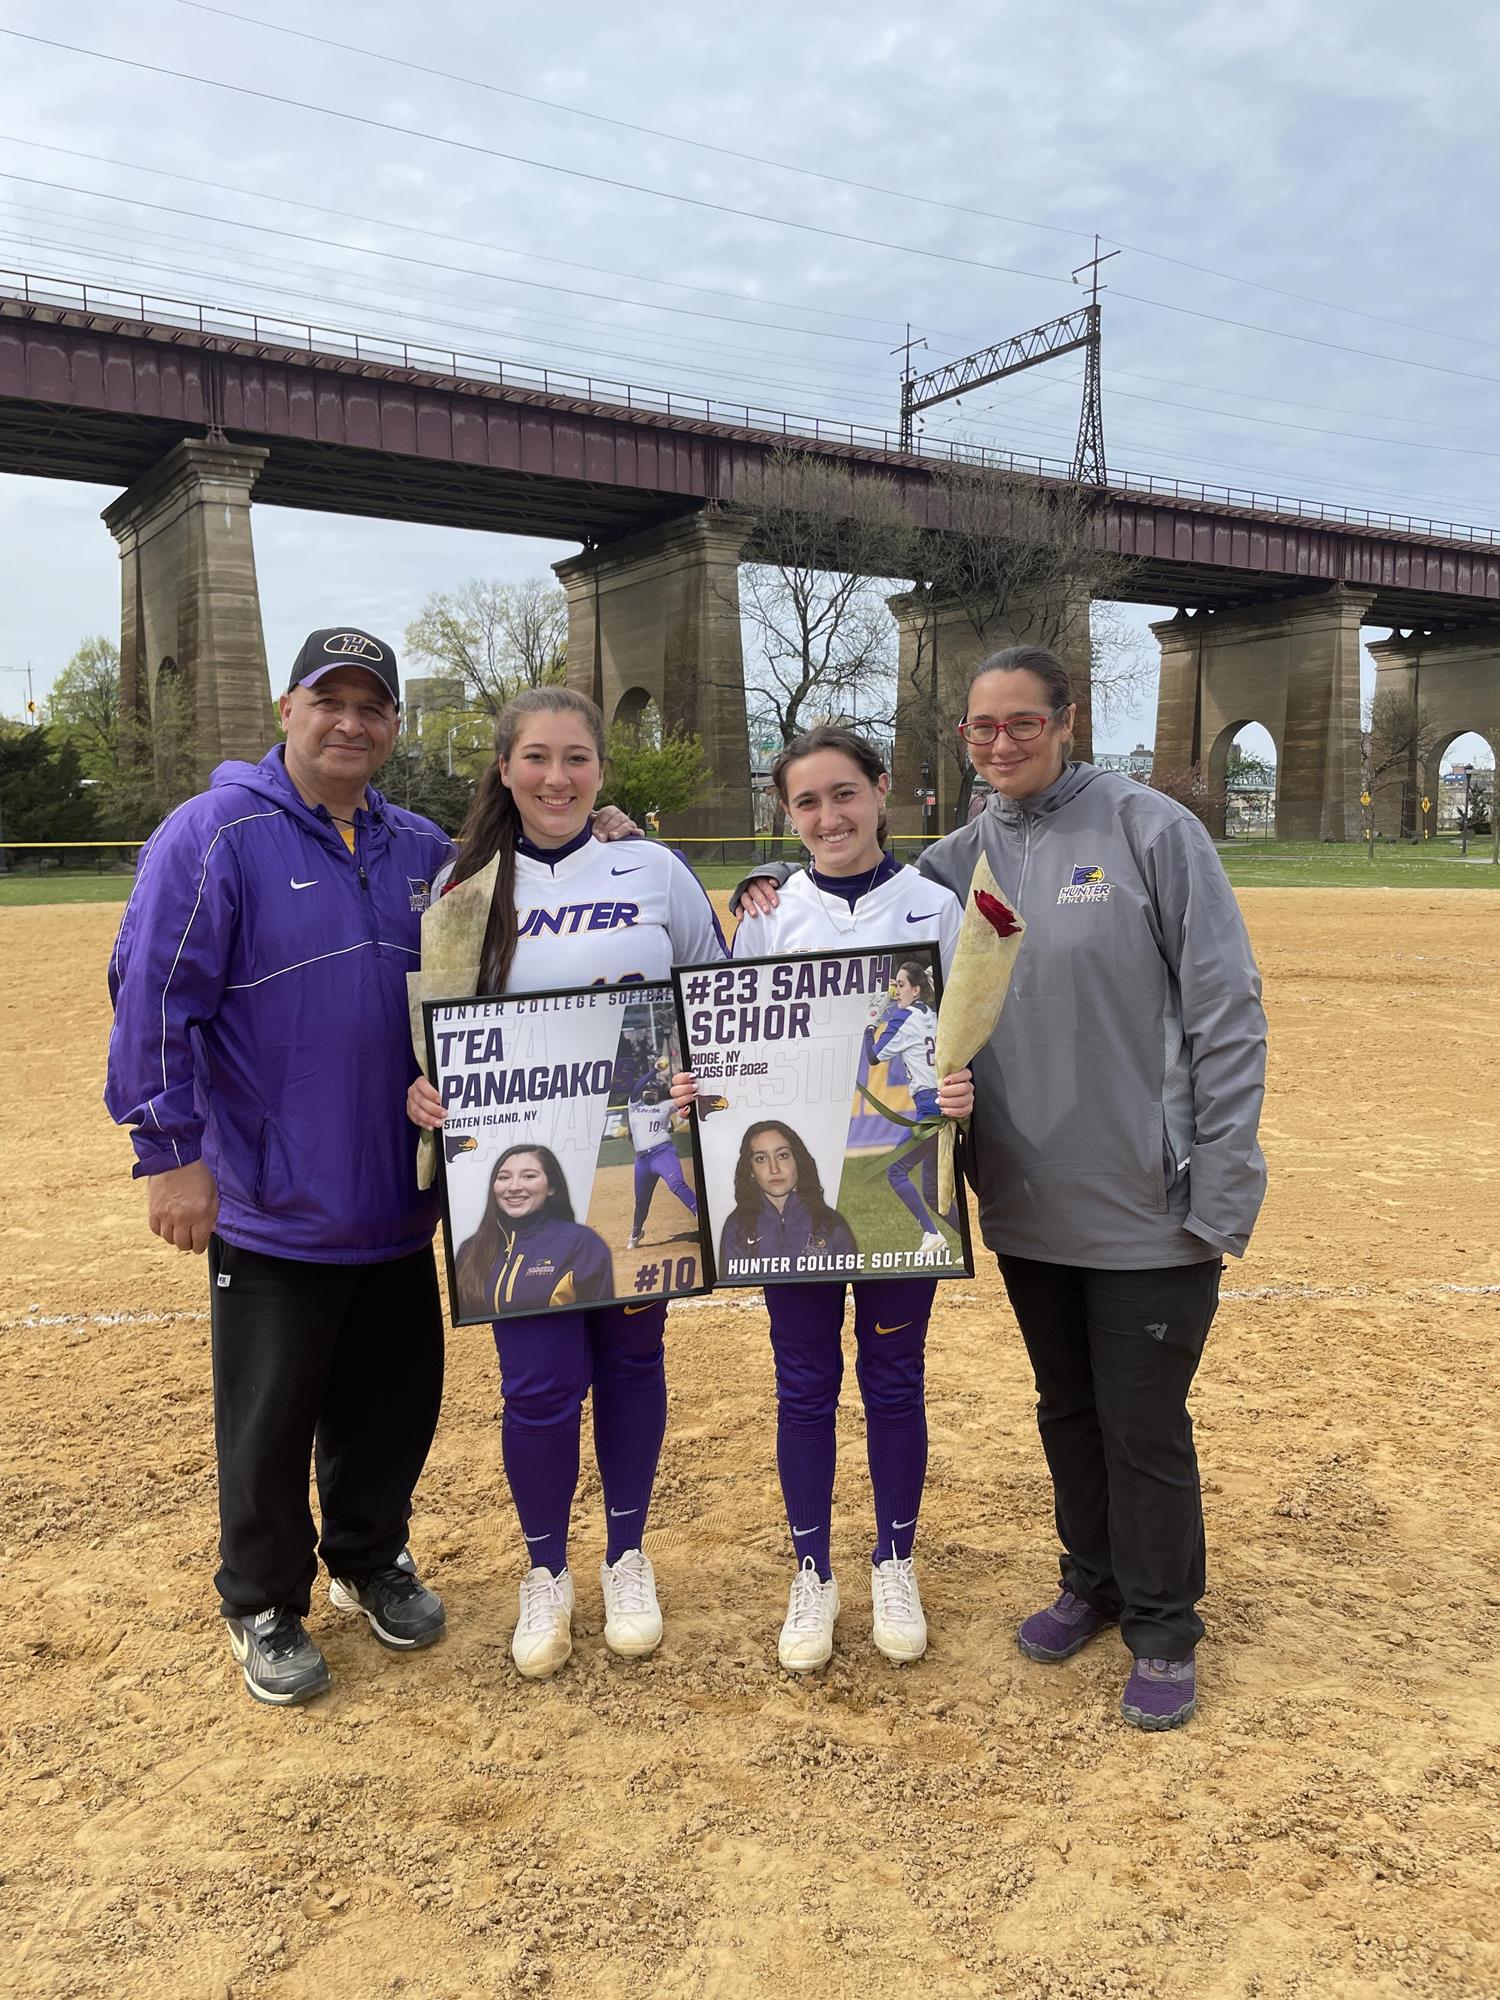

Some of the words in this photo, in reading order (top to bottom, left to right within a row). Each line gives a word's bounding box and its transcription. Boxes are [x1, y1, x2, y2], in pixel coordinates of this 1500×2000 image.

[1056, 896, 1108, 905] ATHLETICS
[1059, 884, 1111, 899] HUNTER
[516, 901, 641, 939] UNTER
[685, 968, 758, 1007] #23
[771, 955, 893, 1002] SARAH
[432, 1003, 504, 1022] HUNTER
[516, 994, 597, 1014] COLLEGE
[608, 986, 673, 1006] SOFTBAL
[691, 1002, 811, 1047] SCHOR
[437, 1027, 505, 1067] T'EA
[726, 1050, 741, 1063] NY
[692, 1065, 723, 1079] CLASS
[725, 1063, 739, 1077] OF
[740, 1062, 768, 1076] 2022
[444, 1116, 480, 1130] STATEN
[482, 1112, 521, 1126] ISLAND,
[524, 1110, 538, 1122] NY
[649, 1121, 661, 1133] 10
[728, 1256, 791, 1275] HUNTER
[797, 1253, 865, 1272] COLLEGE
[871, 1249, 953, 1269] SOFTBALL
[634, 1256, 697, 1293] #10
[255, 1606, 276, 1628] NIKE
